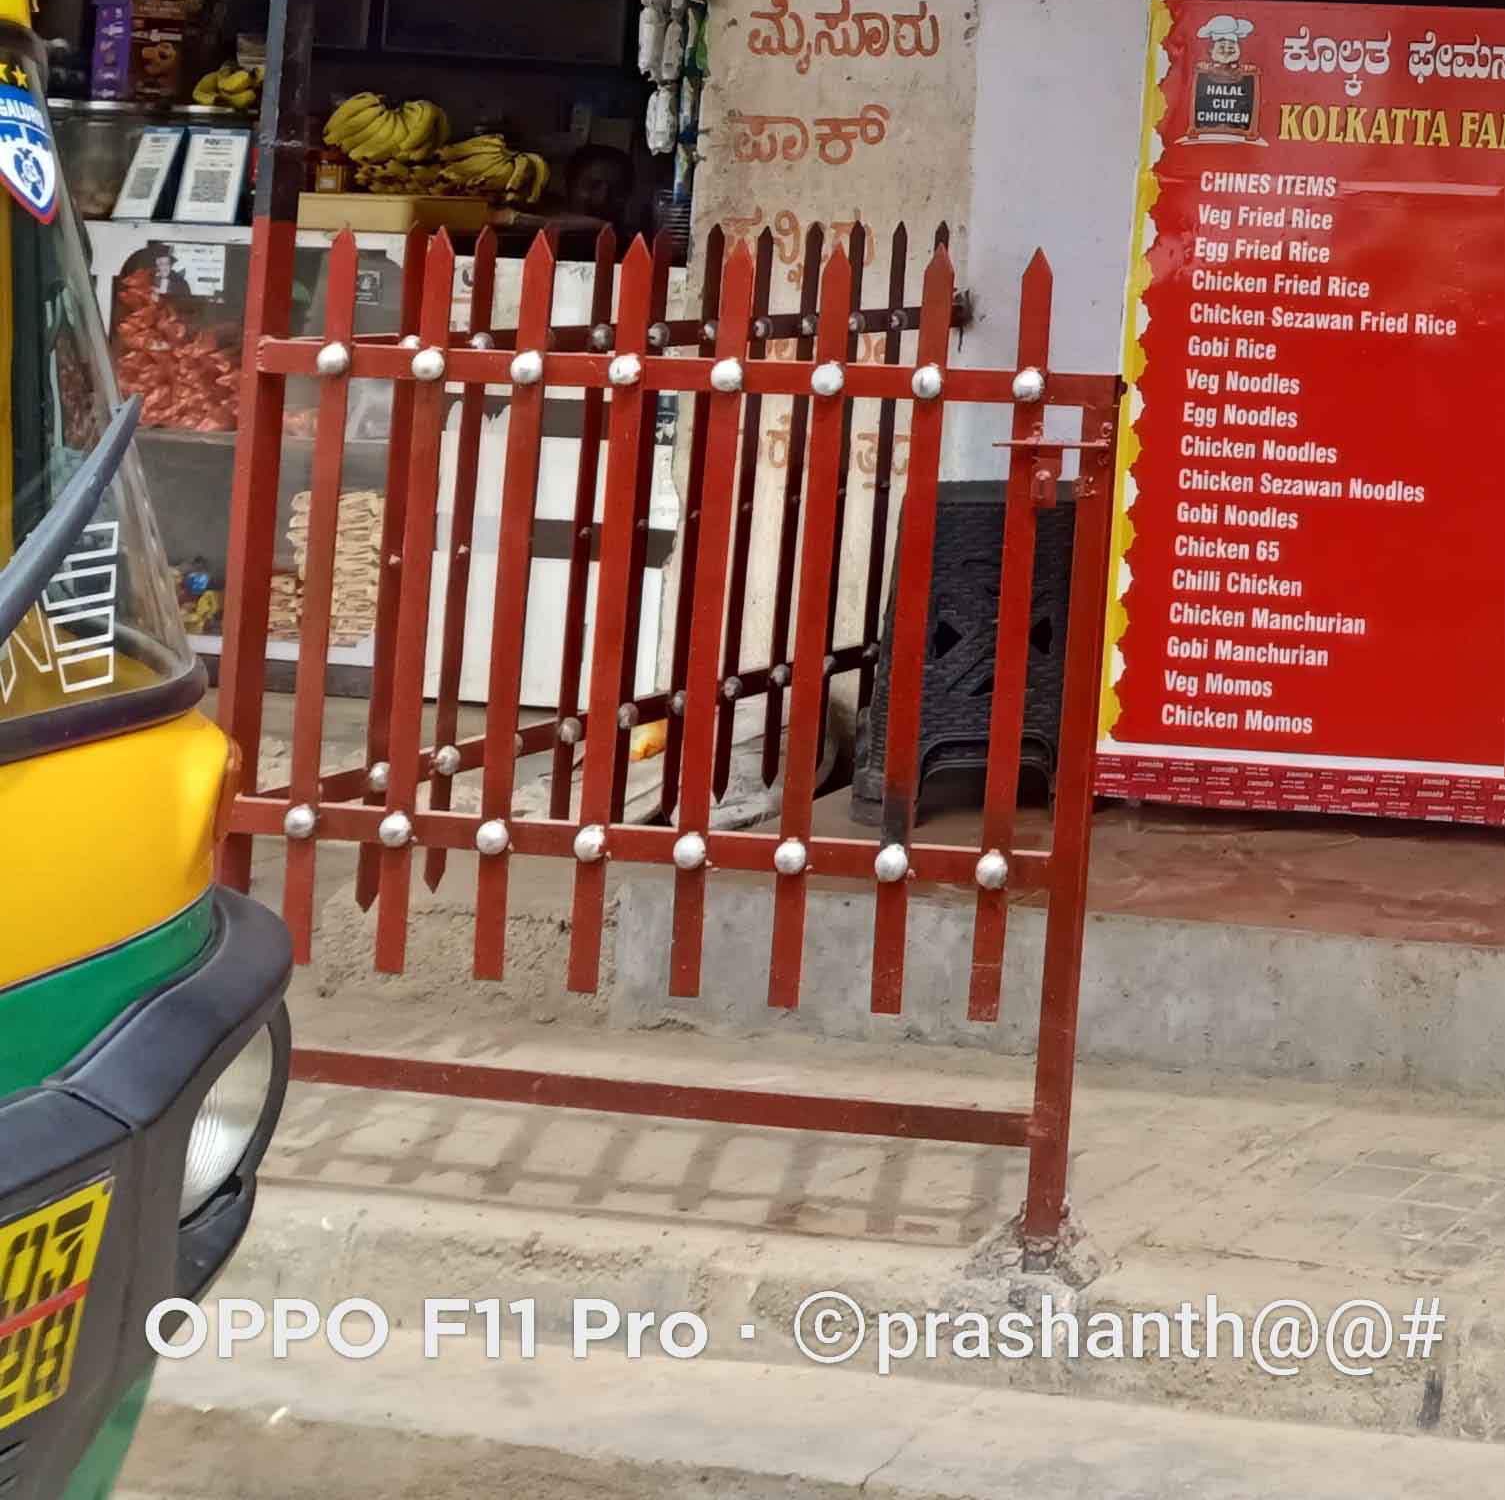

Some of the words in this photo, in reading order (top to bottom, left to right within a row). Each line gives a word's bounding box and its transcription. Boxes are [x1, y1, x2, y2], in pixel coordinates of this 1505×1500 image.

[1282, 25, 1391, 96] ಕೊಲ್ಕತ
[1206, 84, 1244, 96] HALAL
[1212, 98, 1237, 109] CUT
[1197, 111, 1250, 124] CHICKEN
[1279, 104, 1451, 147] KOLKATTA
[1200, 171, 1272, 195] CHINES
[1276, 174, 1337, 197] ITEMS
[1198, 203, 1232, 230] Veg
[1237, 206, 1286, 228] Fried
[1291, 207, 1333, 230] Rice
[1194, 236, 1229, 263] Egg
[1234, 238, 1283, 261] Fried
[1288, 240, 1330, 263] Rice
[1191, 268, 1268, 293] Chicken
[1273, 273, 1322, 296] Fried
[1327, 275, 1370, 298] Rice
[1190, 302, 1265, 326] Chicken
[1270, 306, 1354, 331] Sezawan
[1360, 310, 1409, 334] Fried
[1414, 313, 1457, 336] Rice
[1187, 335, 1230, 358] Gobi
[1235, 337, 1277, 361] Rice
[1186, 368, 1220, 395] Veg
[1225, 370, 1300, 395] Noodles
[1183, 401, 1218, 429] Egg
[1223, 403, 1298, 429] Noodles
[1180, 434, 1256, 459] Chicken
[1262, 439, 1337, 464] Noodles
[1178, 468, 1254, 493] Chicken
[1259, 472, 1343, 498] Sezawan
[1348, 477, 1425, 503] Noodles
[1176, 501, 1218, 525] Gobi
[1224, 504, 1299, 530] Noodles
[1174, 534, 1250, 560] Chicken
[1256, 540, 1280, 562] 65
[1172, 568, 1221, 592] Chilli
[1226, 571, 1303, 597] Chicken
[1169, 602, 1245, 628] Chicken
[1251, 607, 1366, 635] Manchurian
[1167, 635, 1209, 659] Gobi
[1214, 639, 1329, 667] Manchurian
[1164, 669, 1199, 698] Veg
[1204, 672, 1273, 698] Momos
[1161, 703, 1239, 730] Chicken
[1244, 709, 1313, 735] Momos
